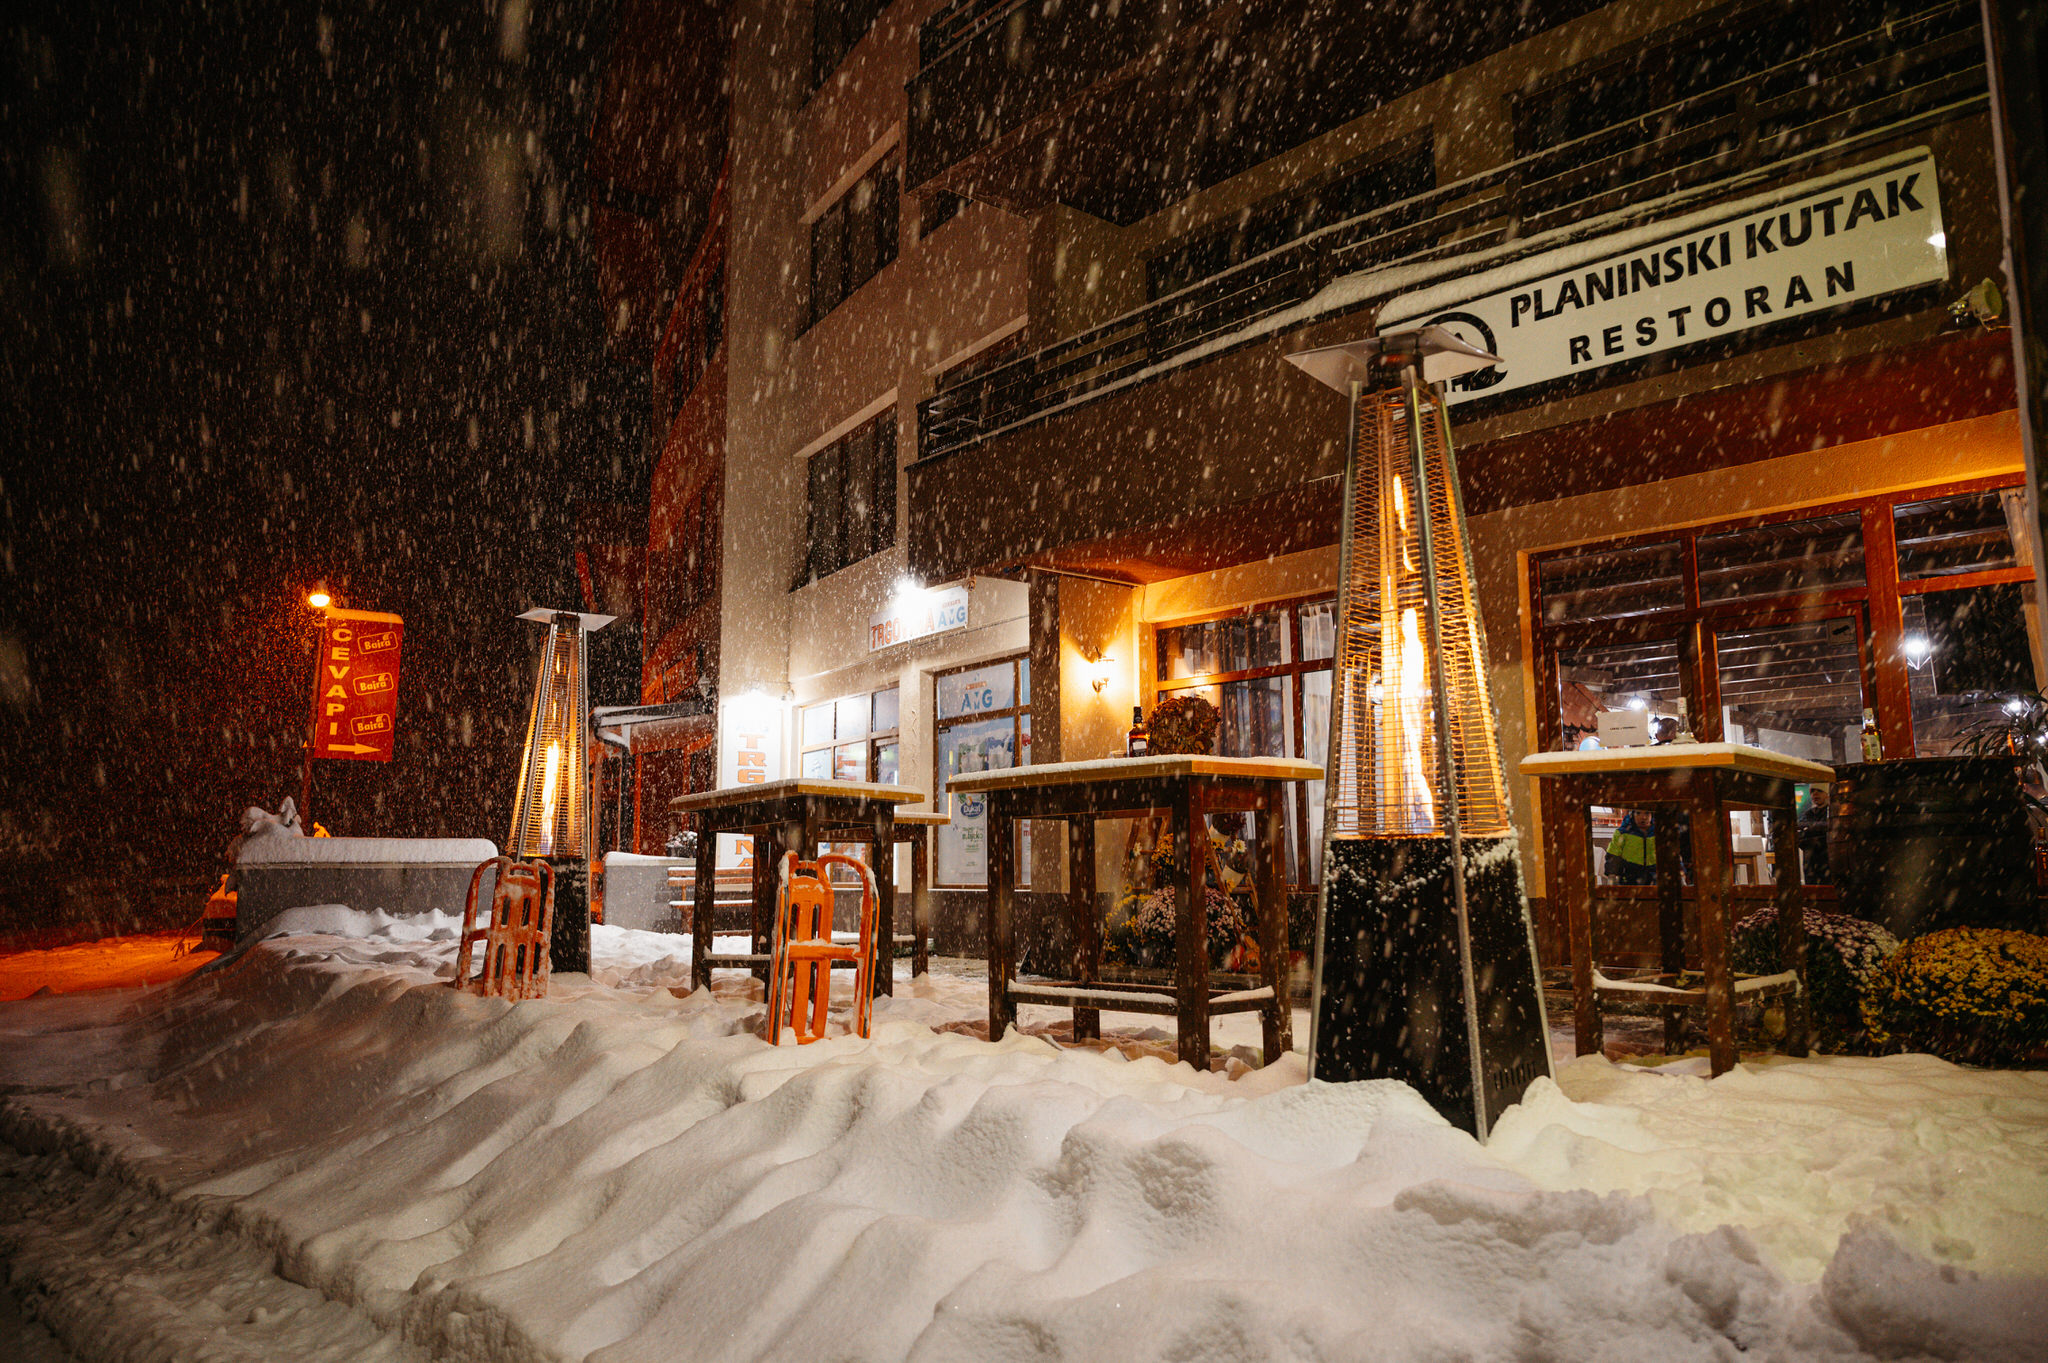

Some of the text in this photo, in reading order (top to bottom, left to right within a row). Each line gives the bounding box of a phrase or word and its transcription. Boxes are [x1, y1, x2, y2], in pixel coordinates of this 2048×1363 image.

[1511, 172, 1924, 328] PLANINSKI KUTAK
[1569, 260, 1855, 365] RESTORAN
[871, 608, 935, 648] TRGOA
